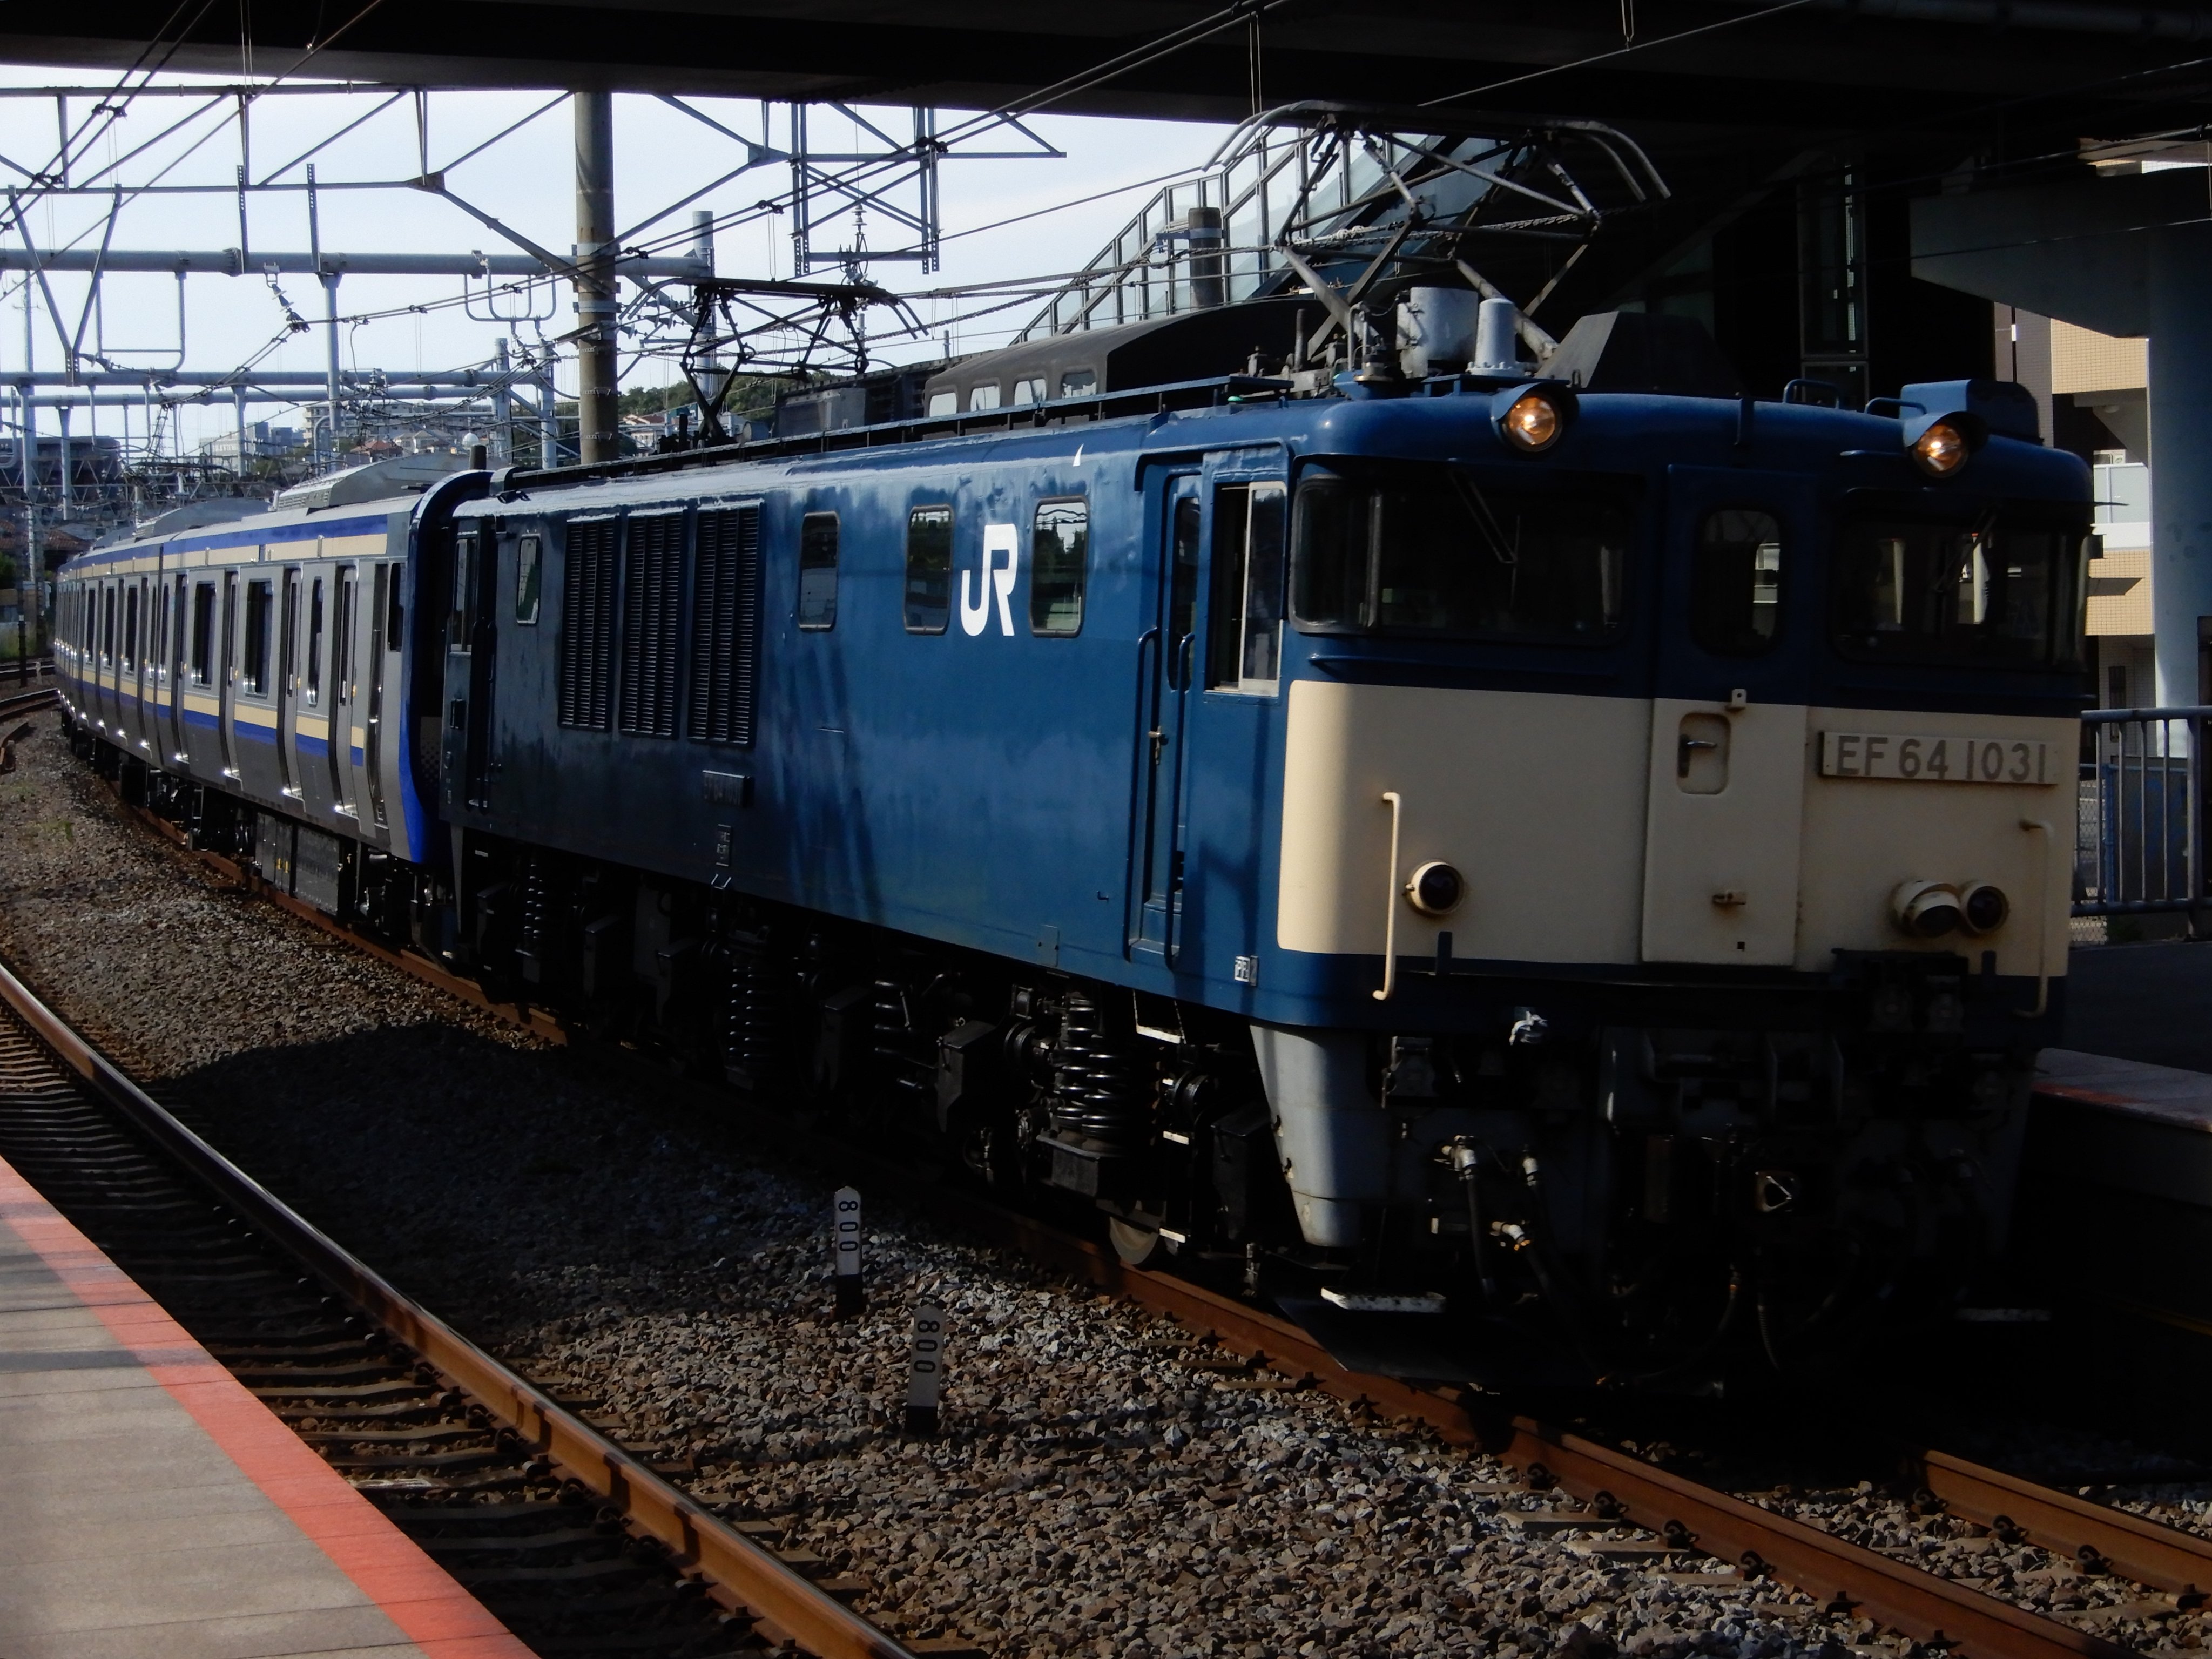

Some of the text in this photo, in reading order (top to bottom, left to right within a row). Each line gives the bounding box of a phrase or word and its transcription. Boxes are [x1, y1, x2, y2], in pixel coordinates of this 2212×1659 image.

[960, 523, 1019, 636] JR
[1837, 736, 2046, 783] EF 64 1031
[839, 1201, 858, 1252] 800
[914, 1320, 940, 1373] 800
